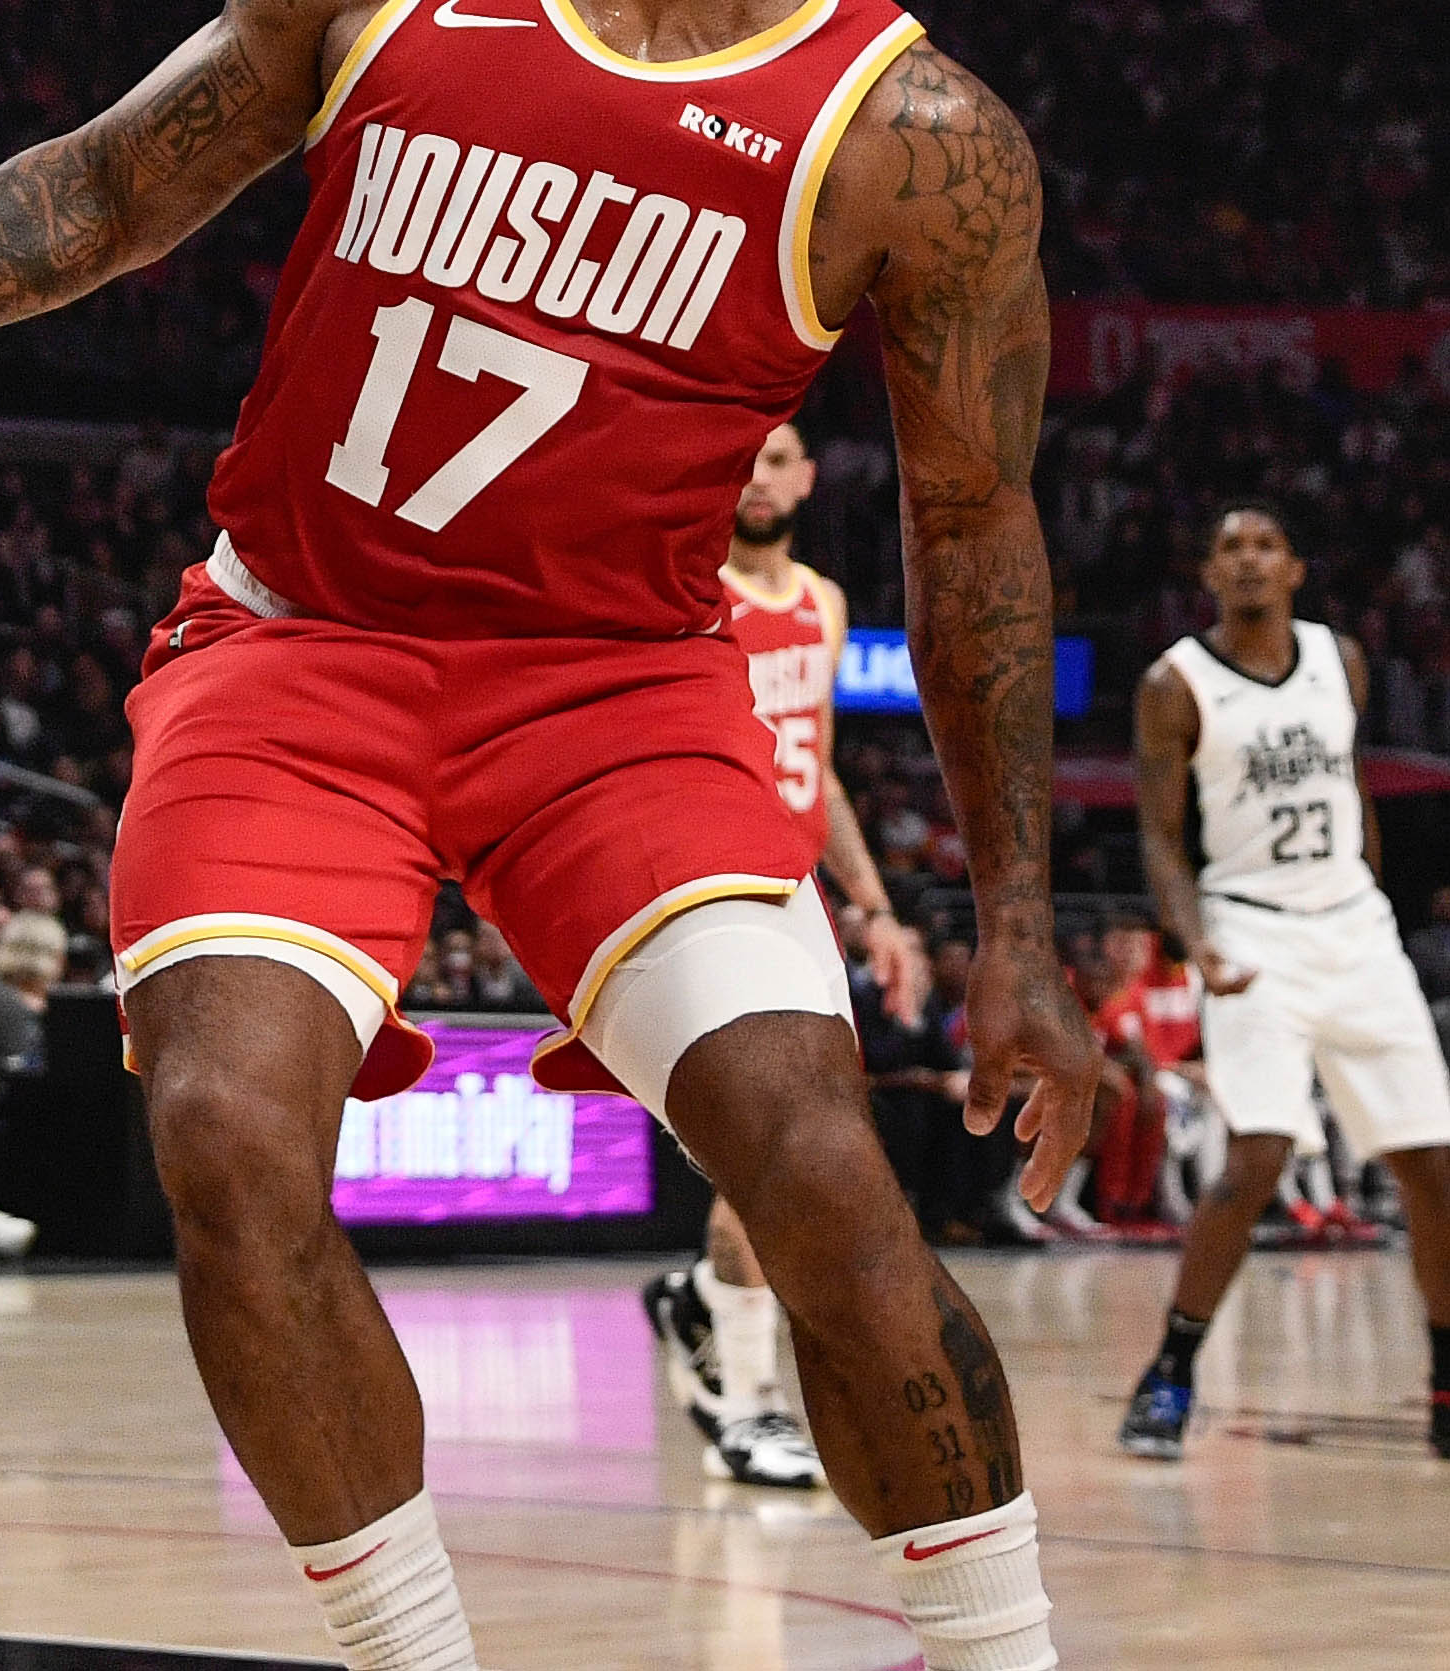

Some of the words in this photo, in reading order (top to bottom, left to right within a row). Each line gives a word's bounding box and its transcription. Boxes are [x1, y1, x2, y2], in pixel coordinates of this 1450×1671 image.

[334, 123, 746, 352] HOUSTON
[324, 295, 590, 533] 17
[1271, 801, 1332, 863] 23
